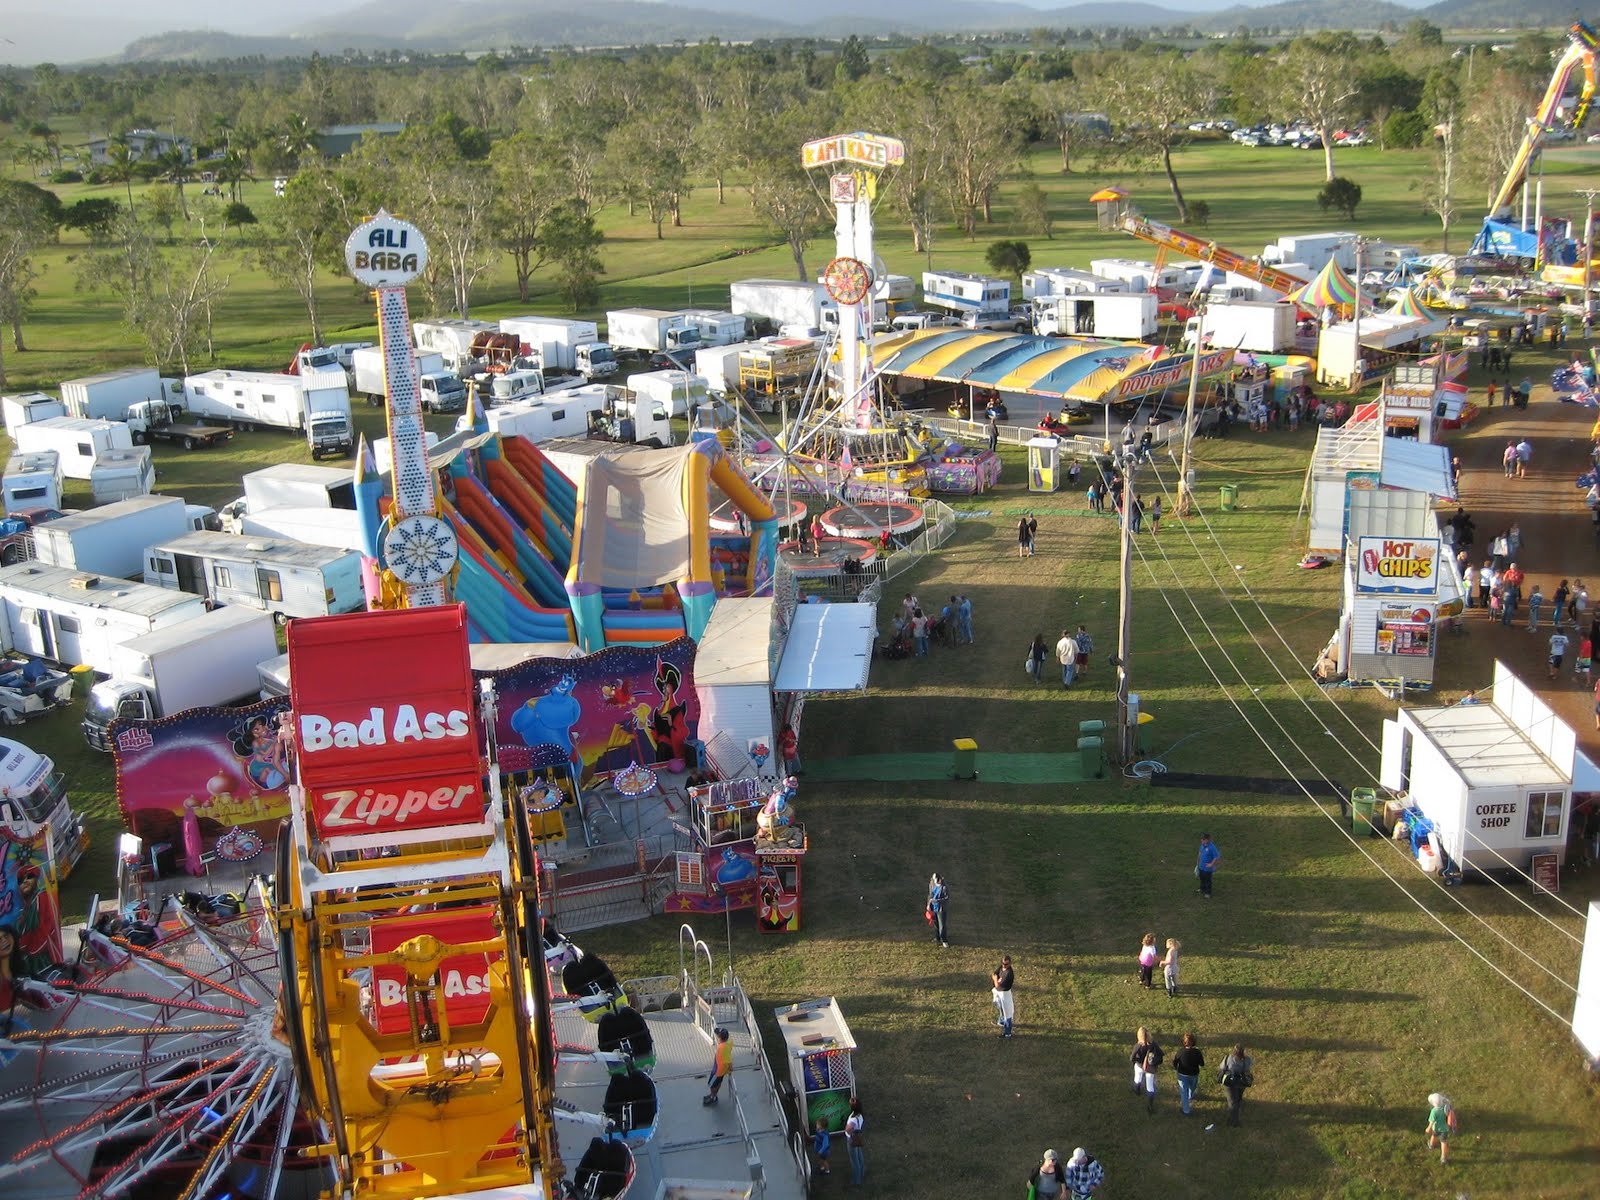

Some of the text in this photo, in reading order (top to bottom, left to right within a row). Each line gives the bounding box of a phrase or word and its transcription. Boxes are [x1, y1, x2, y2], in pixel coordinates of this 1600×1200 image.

[804, 138, 885, 165] KAMIKAZE
[369, 228, 407, 248] ALI
[355, 251, 418, 272] BABA
[1119, 366, 1183, 394] DODGEM
[1383, 541, 1414, 558] HOT
[1378, 559, 1432, 578] CHIPS
[119, 728, 149, 741] GILL
[300, 704, 470, 752] Bad Ass
[120, 737, 152, 747] BROS
[322, 784, 475, 826] Zipper
[1475, 803, 1517, 815] COFFEE
[1480, 817, 1511, 828] SHOP
[761, 855, 797, 863] TICKETS
